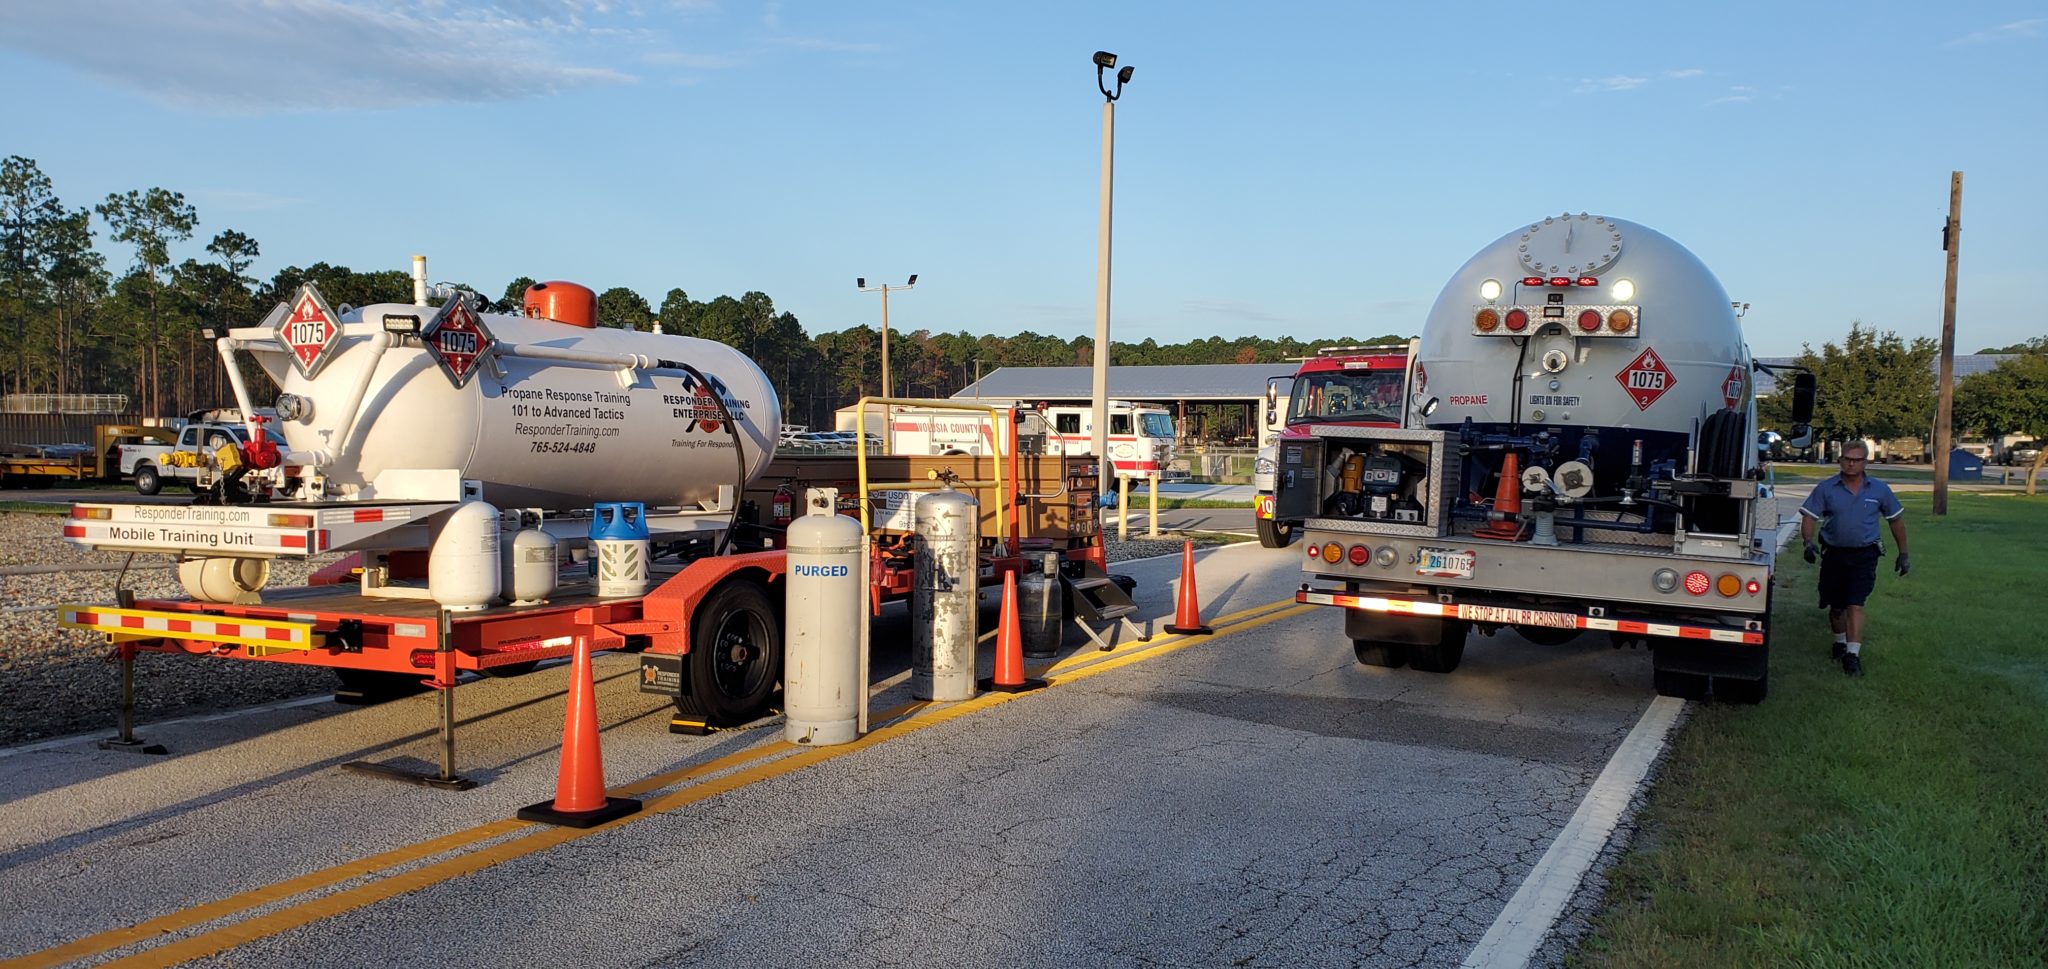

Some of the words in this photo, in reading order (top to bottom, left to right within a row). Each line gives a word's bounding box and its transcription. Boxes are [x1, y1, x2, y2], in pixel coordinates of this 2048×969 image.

[293, 323, 323, 343] 1075
[443, 332, 475, 353] 1075
[1632, 372, 1663, 388] 1075
[500, 386, 543, 403] Propane
[545, 388, 593, 403] Response
[594, 391, 631, 406] Training
[663, 394, 713, 406] RESPONDER
[720, 399, 750, 409] AINING
[1449, 395, 1488, 405] PROPANE
[1529, 395, 1544, 405] LIGHTS
[1545, 395, 1553, 405] ON
[1553, 396, 1562, 406] FOR
[1562, 396, 1580, 407] SAFETY
[1641, 396, 1649, 405] 2
[511, 404, 528, 417] 101
[531, 405, 542, 417] to
[544, 405, 591, 419] Advanced
[593, 407, 625, 420] Tactics
[731, 411, 744, 421] LLC
[515, 422, 620, 439] ResponderTraining.com
[918, 422, 948, 433] VOLUSIA
[950, 423, 978, 434] COUNTY
[530, 442, 596, 453] 765-524-4848
[671, 439, 695, 449] Training
[696, 440, 707, 448] For
[888, 491, 912, 500] USDOT
[1260, 499, 1273, 513] 10
[134, 506, 250, 524] ResponderTraining.com
[109, 527, 155, 541] Mobile
[160, 529, 218, 547] Training
[223, 531, 254, 545] Unit
[795, 565, 848, 577] PURGED
[1461, 605, 1473, 618] WE
[1474, 606, 1493, 620] STOP
[1495, 608, 1504, 621] AT
[1507, 609, 1519, 623] ALL
[1521, 610, 1532, 624] RR
[1533, 611, 1575, 629] CROSSINGS
